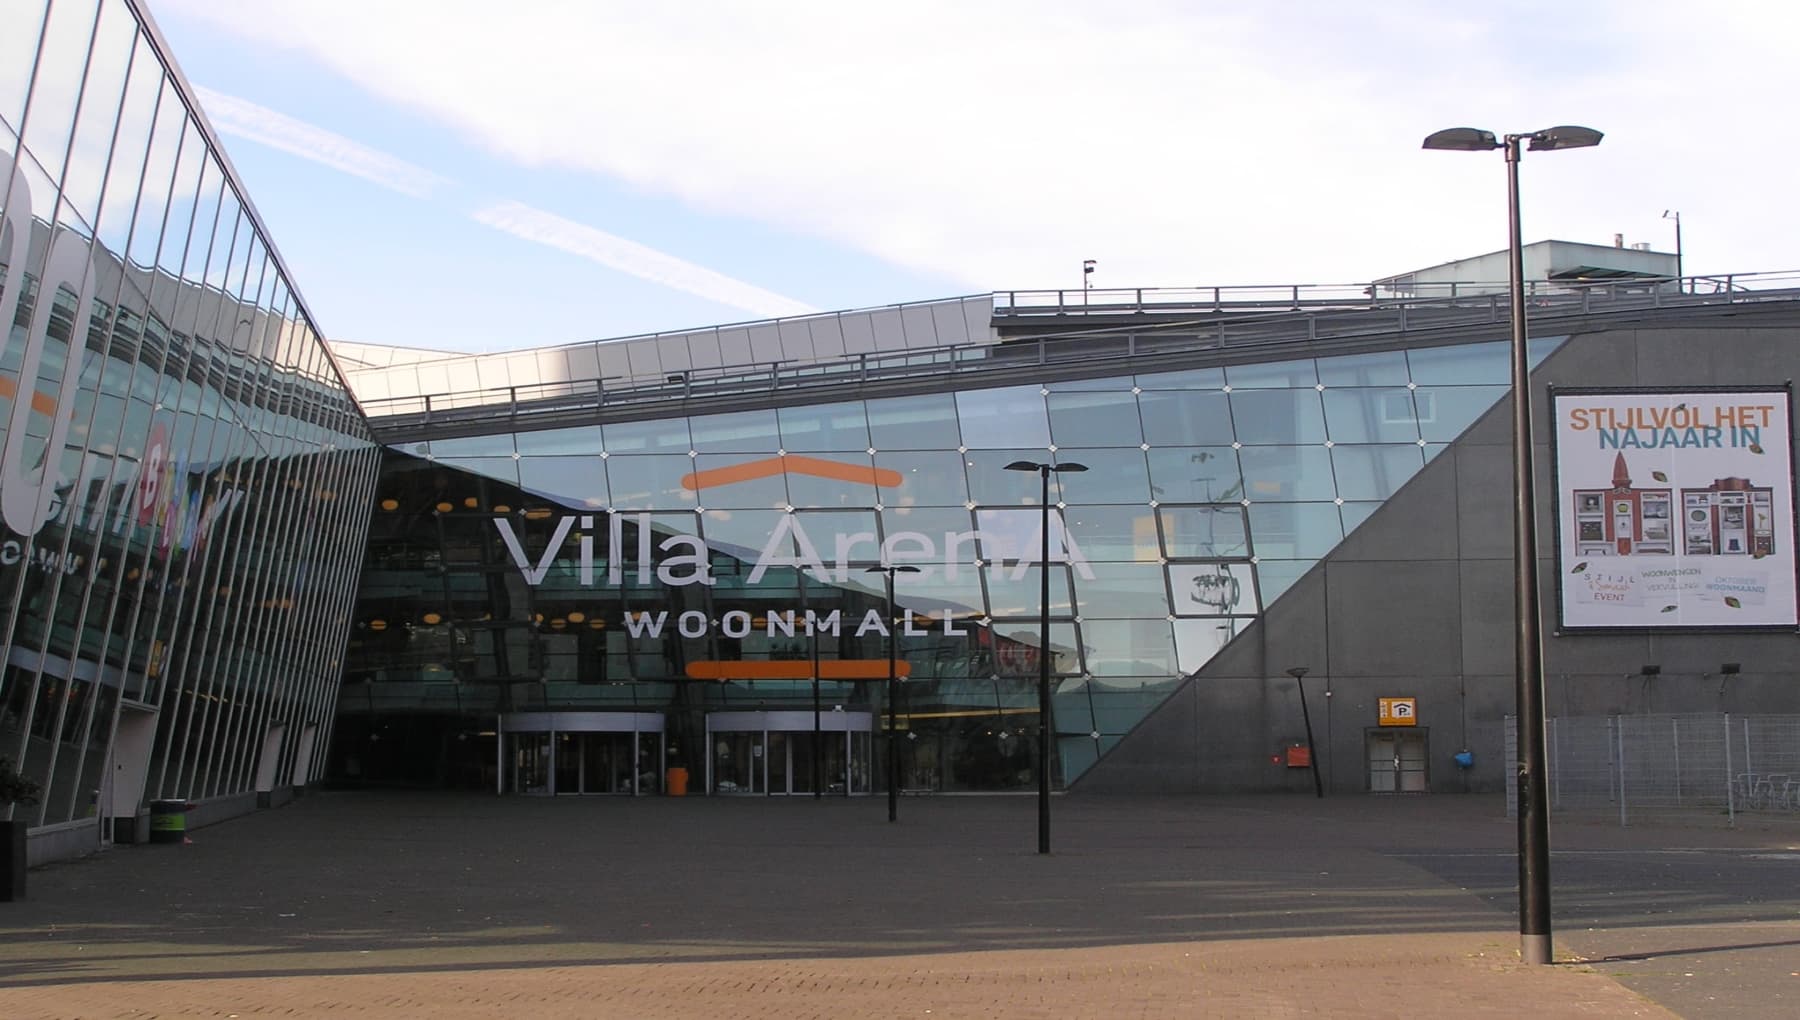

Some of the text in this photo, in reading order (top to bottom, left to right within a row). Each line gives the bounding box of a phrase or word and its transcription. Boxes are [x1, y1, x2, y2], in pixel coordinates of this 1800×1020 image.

[1570, 405, 1774, 430] STIJLVOL HET
[1601, 425, 1760, 450] NAJAAR IN
[493, 513, 1097, 586] Villa ArenA
[623, 608, 968, 639] WOONMALL
